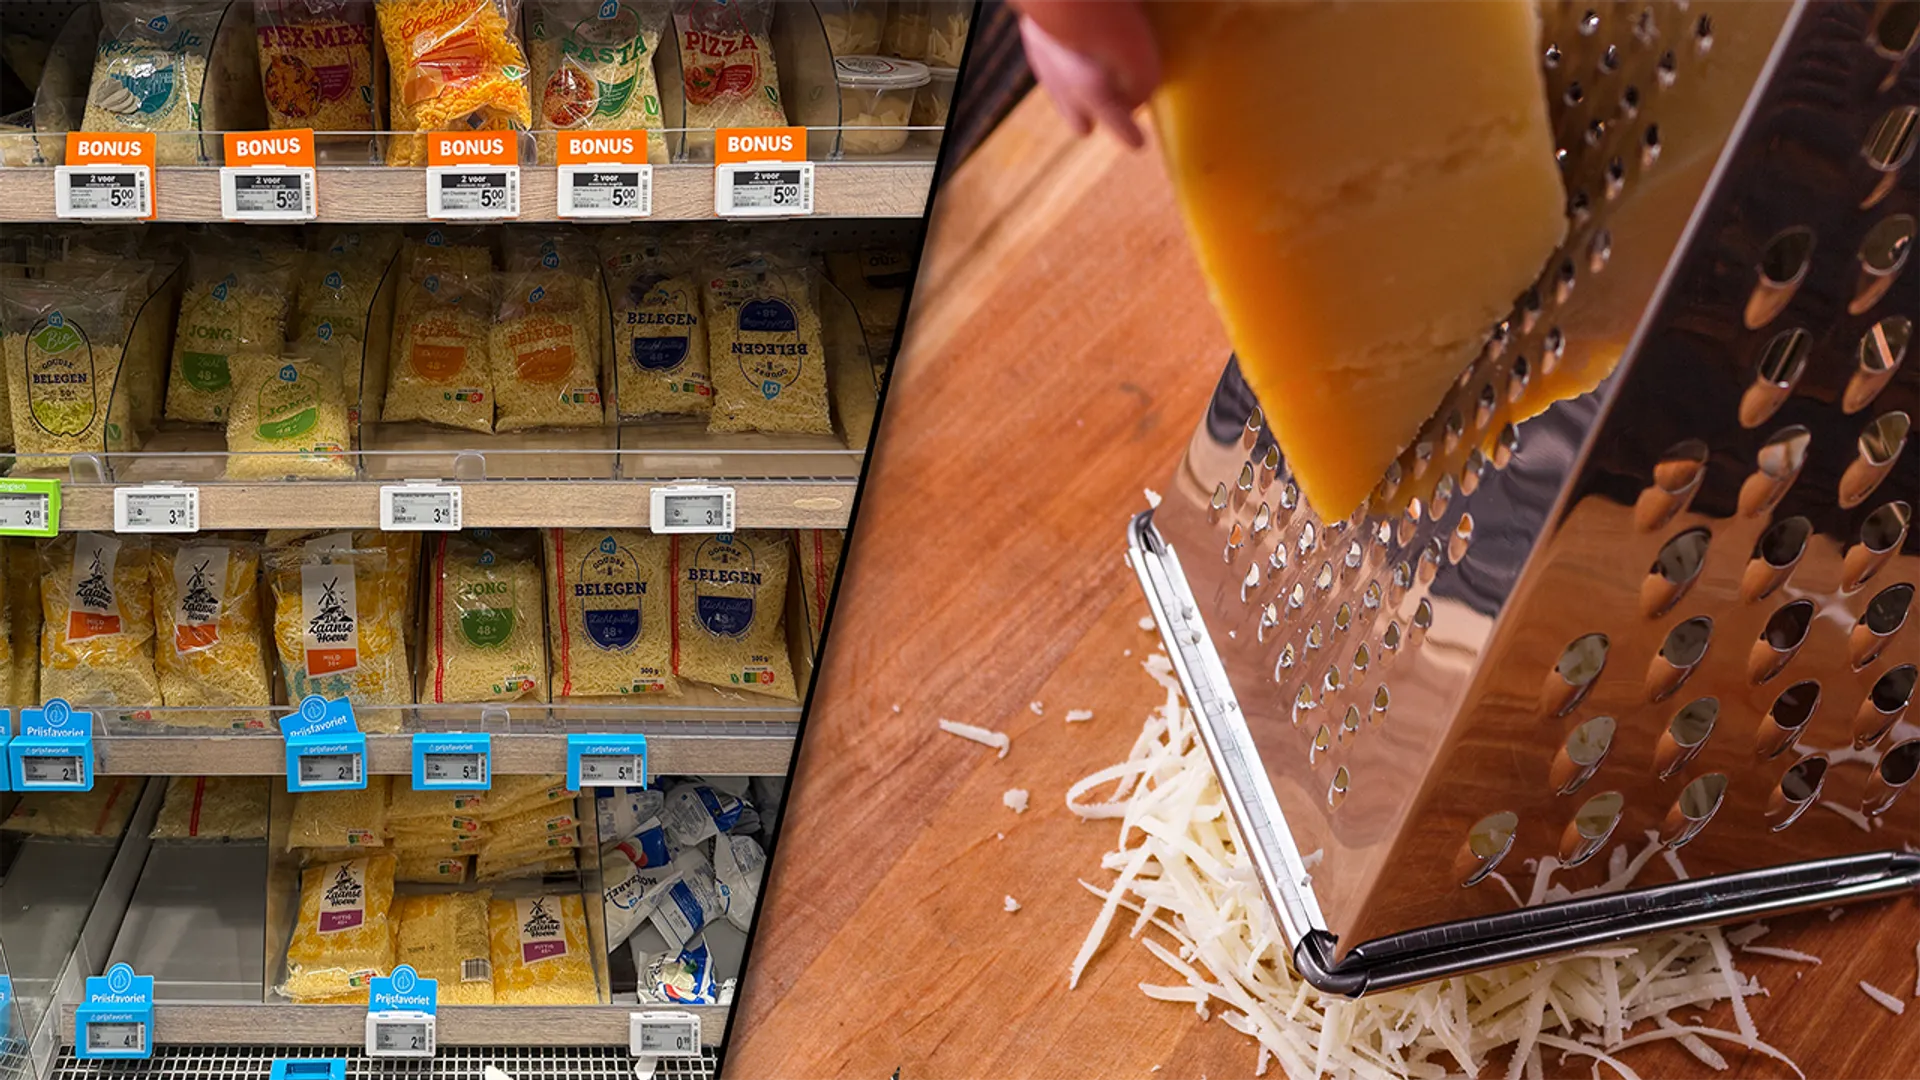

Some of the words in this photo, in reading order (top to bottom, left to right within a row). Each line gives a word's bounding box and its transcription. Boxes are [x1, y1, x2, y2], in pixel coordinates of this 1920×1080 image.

[256, 24, 371, 49] TEX-MEX
[684, 30, 758, 57] PIZZA
[562, 35, 647, 66] PASTA
[78, 140, 143, 156] BONUS
[236, 137, 301, 156] BONUS
[440, 138, 505, 156] BONUS
[569, 138, 634, 155] BONUS
[728, 135, 793, 152] BONUS
[90, 175, 97, 183] 2
[255, 177, 262, 185] 2
[263, 177, 281, 185] voor
[461, 175, 468, 184] 2
[469, 175, 487, 183] voor
[593, 174, 600, 183] 2
[601, 174, 619, 182] voor
[754, 172, 761, 181] 2
[762, 172, 780, 181] voor
[627, 311, 697, 325] BELEGEN
[188, 324, 232, 341] JONG
[508, 324, 574, 348] BELEGEN
[46, 331, 72, 350] Bio
[732, 342, 809, 355] BELEGEN
[33, 373, 88, 384] BELEGEN
[268, 396, 312, 417] JONG
[592, 556, 625, 569] GOUDSE
[688, 568, 763, 585] BELEGEN
[466, 581, 507, 595] JONG
[575, 582, 648, 596] BELEGEN
[309, 620, 354, 634] Zaanse
[477, 624, 504, 636] 48+
[603, 626, 624, 638] 48+
[316, 632, 349, 643] Hoeve
[27, 726, 84, 737] Prijsfavoriet
[290, 715, 348, 737] Prijsfavoriet
[324, 888, 362, 900] Zaanse
[523, 923, 560, 933] Zaanse
[91, 993, 146, 1004] Prijsfavoriet
[375, 992, 430, 1009] Prijsfavoriet
